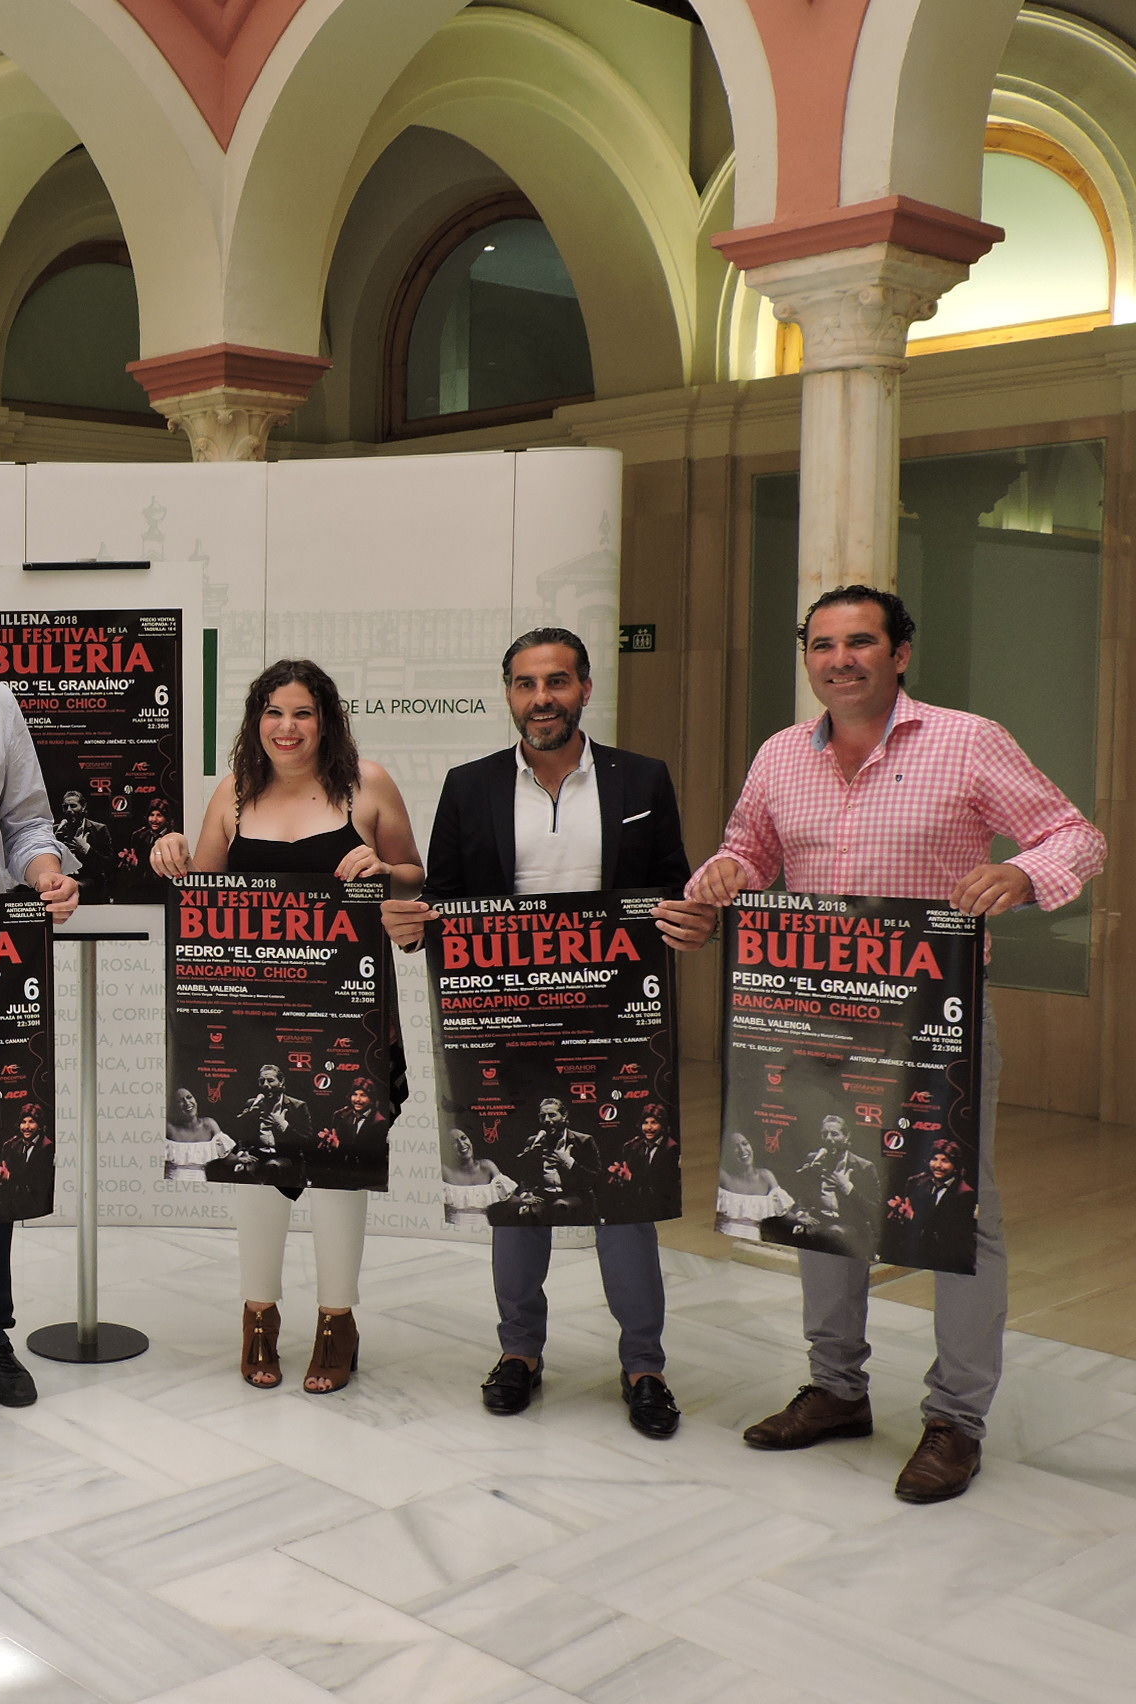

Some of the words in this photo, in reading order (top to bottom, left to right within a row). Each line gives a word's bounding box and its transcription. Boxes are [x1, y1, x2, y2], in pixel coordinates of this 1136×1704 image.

[53, 615, 77, 624] 2018
[22, 627, 109, 643] FESTIVAL
[154, 684, 169, 705] 6
[66, 698, 106, 708] CHICO
[365, 699, 385, 714] LA
[391, 698, 486, 715] PROVINCIA
[138, 707, 169, 717] JULIO
[24, 717, 52, 725] LENCIA
[172, 874, 247, 888] GUILLENA
[251, 878, 276, 888] 2018
[179, 890, 208, 905] XII
[217, 890, 310, 908] FESTIVAL
[817, 900, 847, 912] 2018
[431, 898, 515, 917] GUILLENA
[518, 899, 547, 910] 2018
[180, 902, 358, 941] BULERÍA
[441, 917, 473, 934] XII
[482, 911, 585, 933] FESTIVAL
[582, 910, 593, 918] DE
[737, 910, 769, 929] XII
[779, 912, 886, 936] FESTIVAL
[883, 918, 895, 926] DE
[898, 919, 910, 927] LA
[175, 944, 223, 957] PEDRO
[442, 920, 640, 969] BULERÍA
[737, 929, 942, 979] BULERÍA
[176, 964, 256, 977] RANCAPINO
[263, 966, 307, 978] CHICO
[359, 955, 374, 977] 6
[340, 980, 375, 990] JULIO
[439, 974, 493, 988] PEDRO
[642, 974, 660, 998] 6
[732, 971, 785, 988] PEDRO
[23, 977, 39, 1000] 6
[176, 983, 208, 991] ANABEL
[209, 984, 247, 993] VALENCIA
[5, 1002, 40, 1014] JULIO
[441, 994, 529, 1009] RANCAPINO
[537, 991, 585, 1005] CHICO
[623, 1000, 661, 1012] JULIO
[731, 993, 821, 1013] RANCAPINO
[829, 1002, 880, 1018] CHICO
[943, 996, 961, 1022] 6
[443, 1017, 478, 1025] ANABEL
[478, 1015, 521, 1024] VALENCIA
[731, 1015, 766, 1026] ANABEL
[767, 1018, 811, 1030] VALENCIA
[920, 1024, 961, 1037] JULIO
